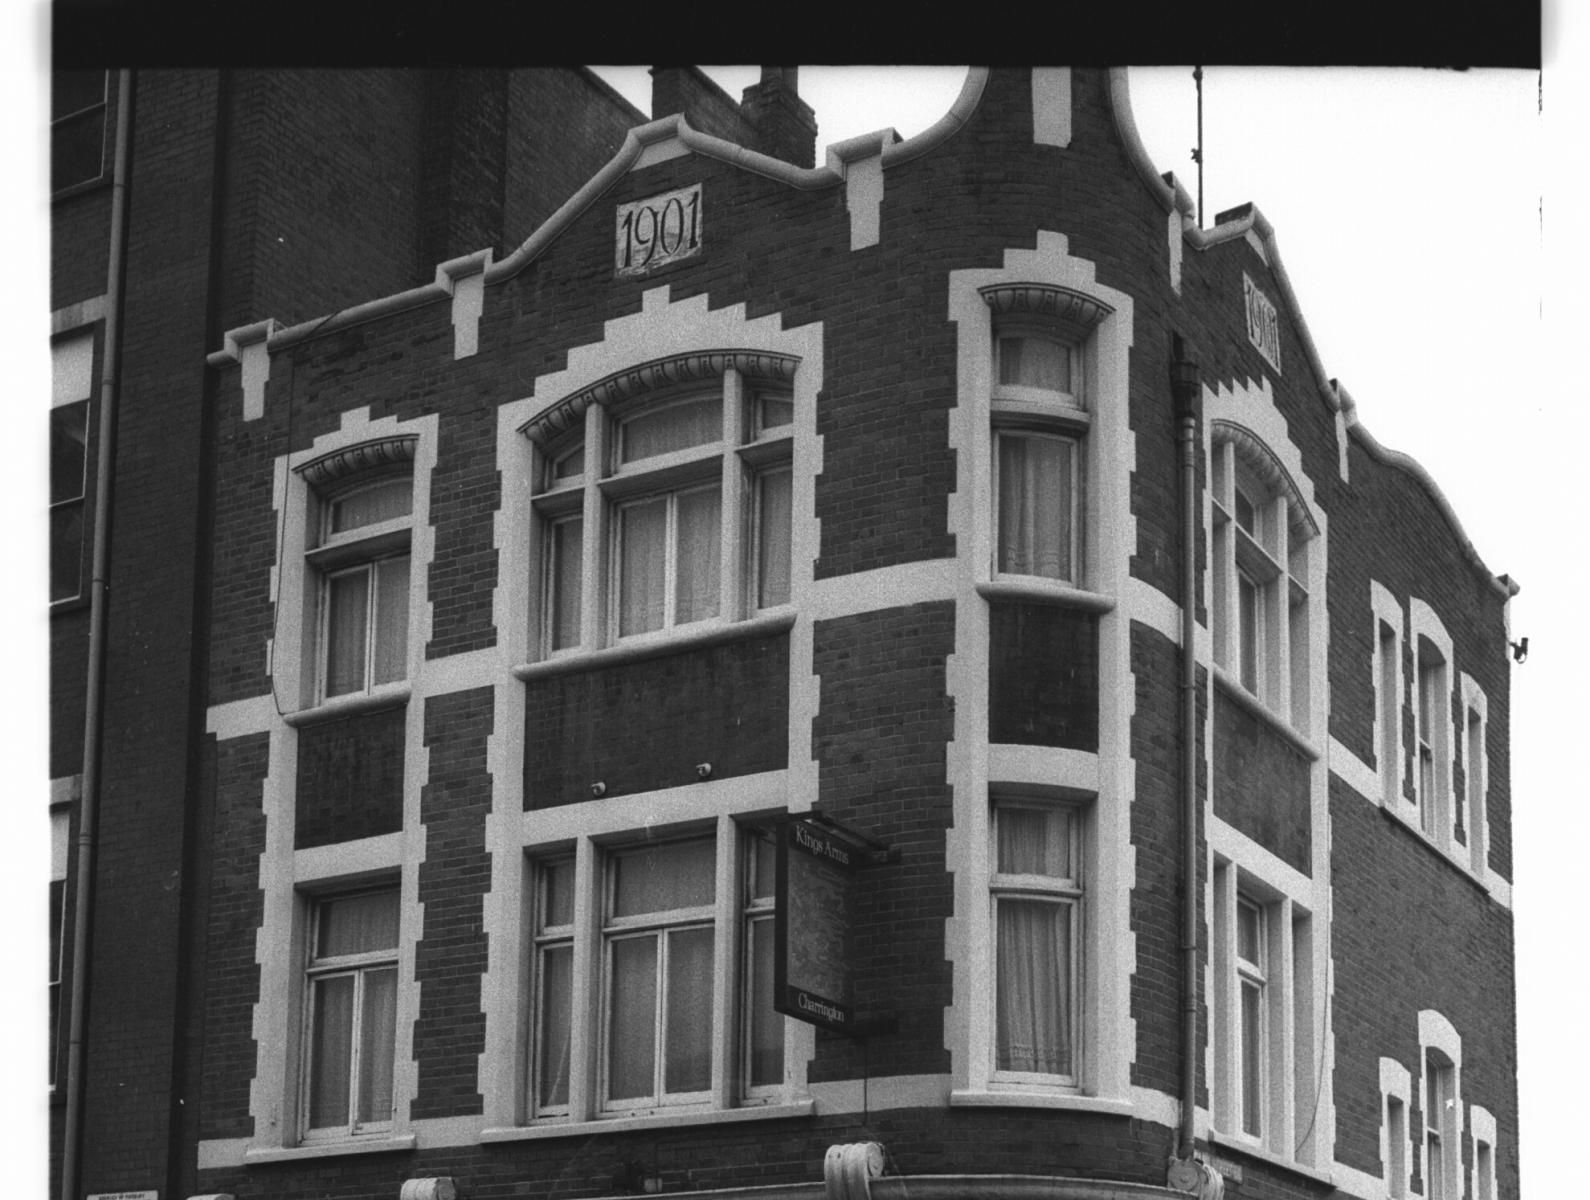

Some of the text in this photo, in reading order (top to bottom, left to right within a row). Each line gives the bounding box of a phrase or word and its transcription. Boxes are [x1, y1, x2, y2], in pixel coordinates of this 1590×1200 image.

[621, 191, 699, 268] 1901
[796, 824, 849, 865] Kings Arms
[799, 992, 844, 1023] Charrington
